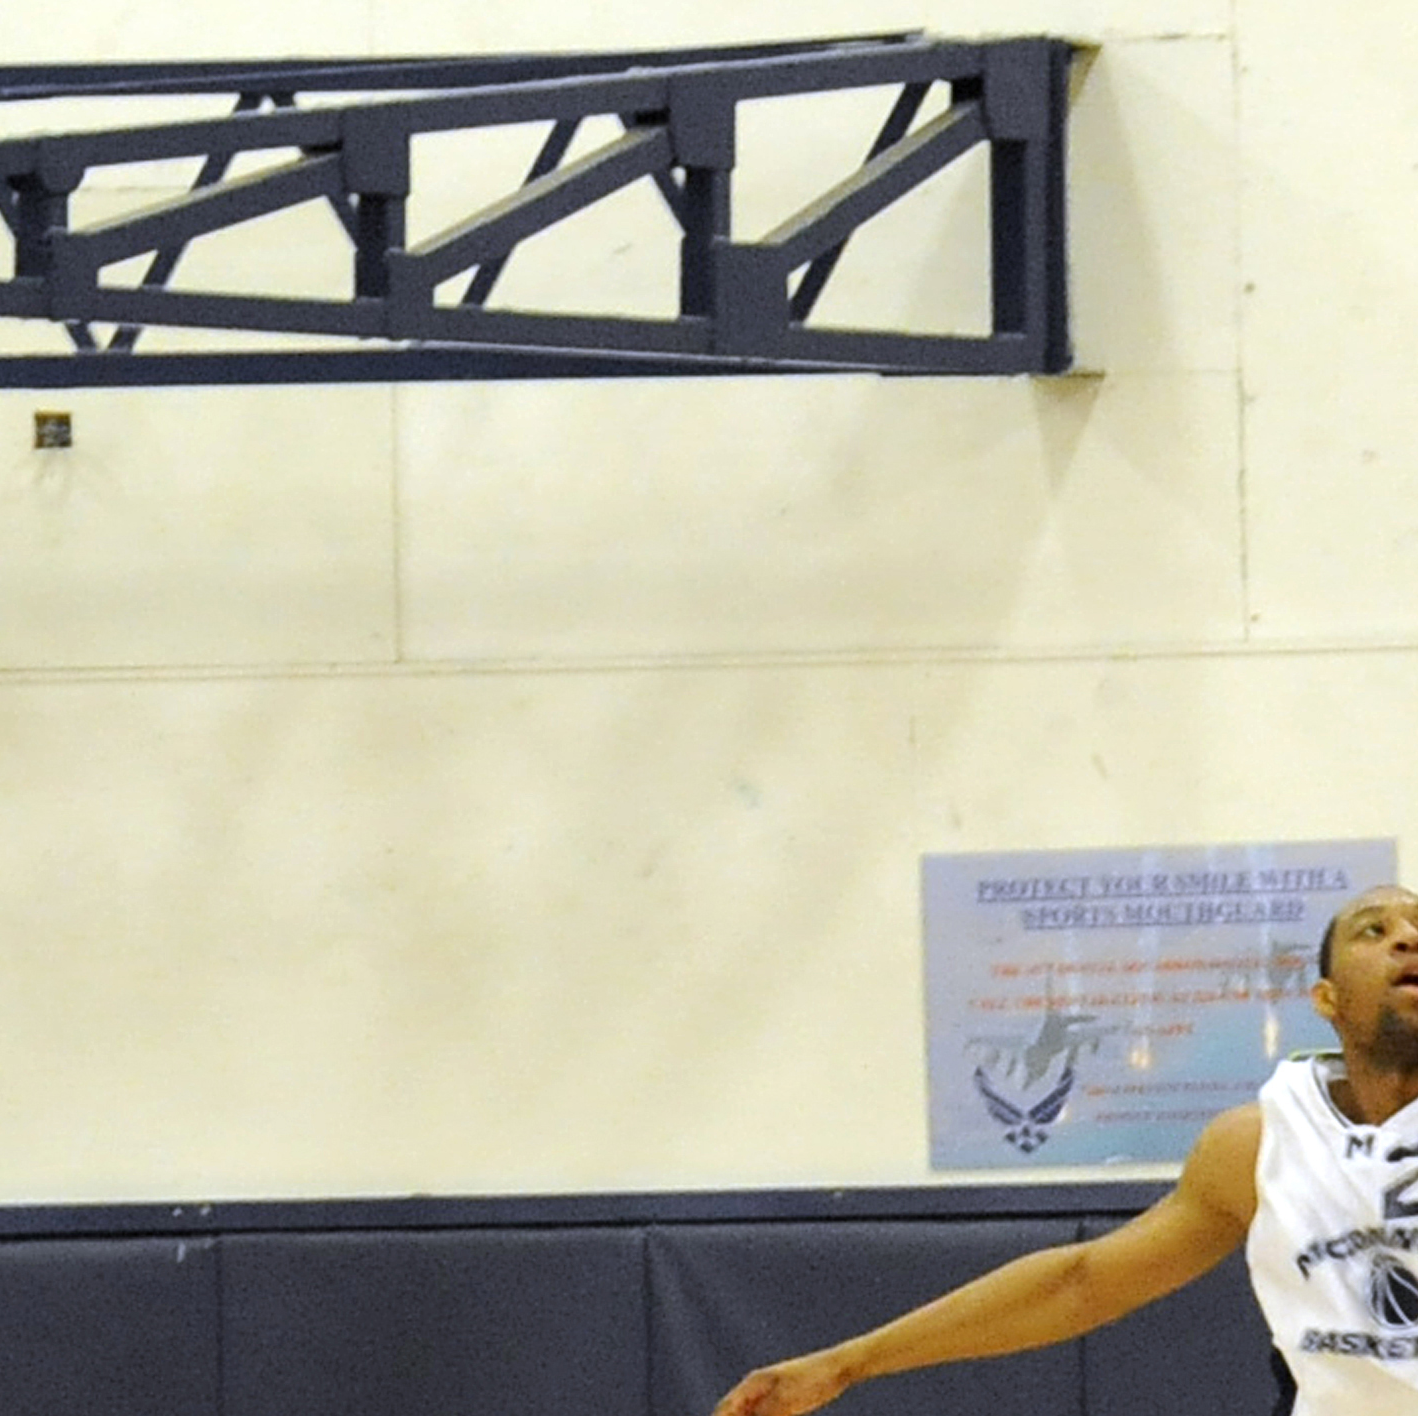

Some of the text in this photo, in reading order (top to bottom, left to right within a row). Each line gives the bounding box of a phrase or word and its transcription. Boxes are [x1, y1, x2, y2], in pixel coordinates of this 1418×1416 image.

[976, 876, 1091, 901] PROTECT
[1101, 873, 1169, 897] YOUR
[1173, 871, 1251, 894] SMILE
[1257, 868, 1327, 892] WITH
[1021, 903, 1117, 929] SPORTS
